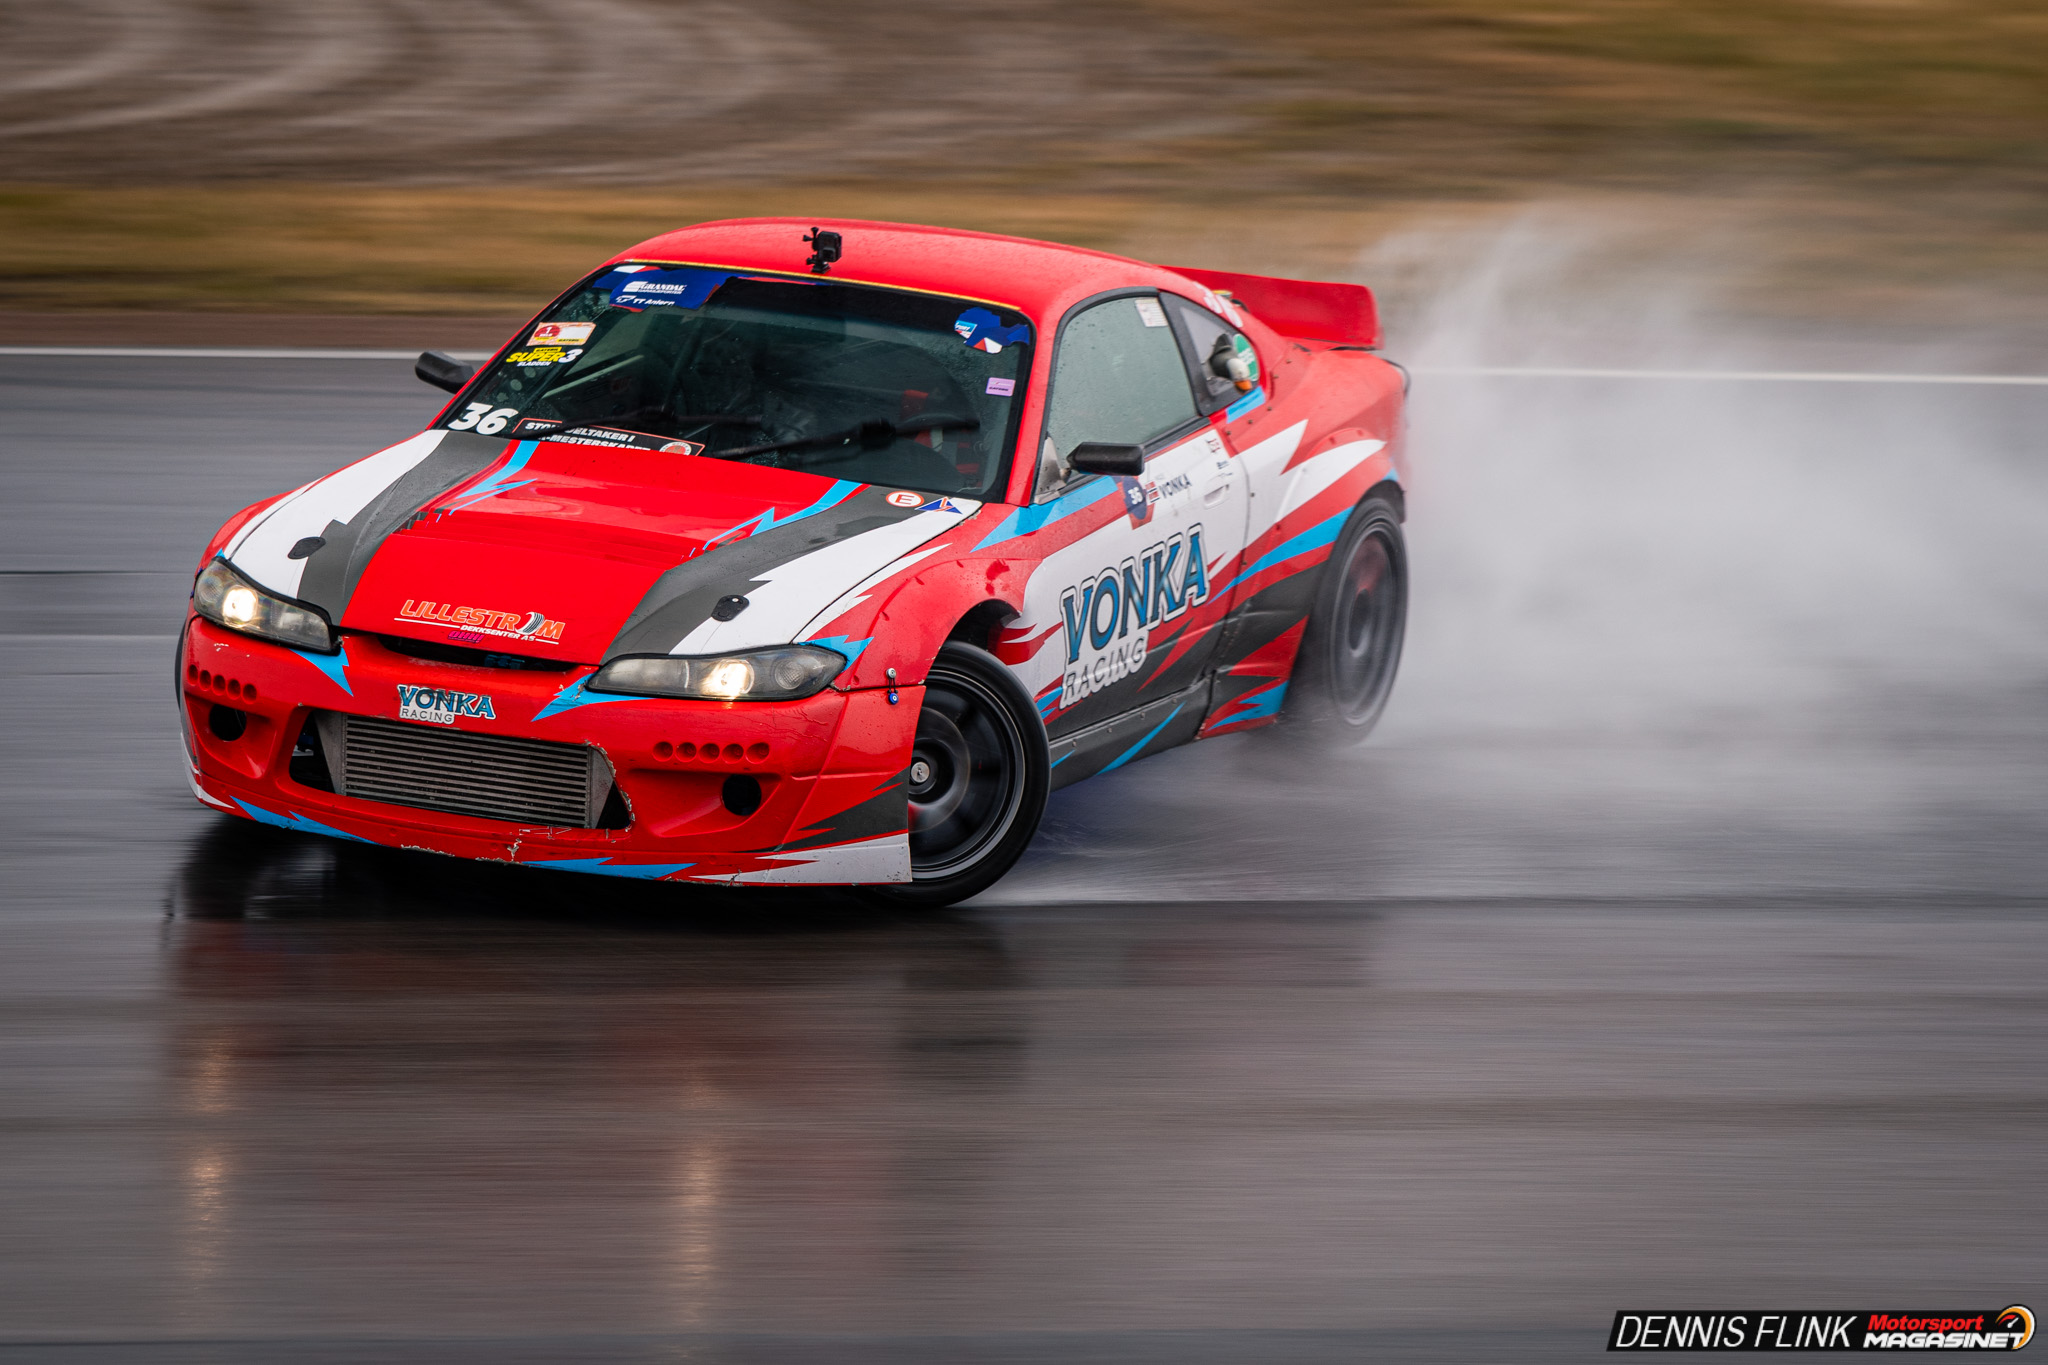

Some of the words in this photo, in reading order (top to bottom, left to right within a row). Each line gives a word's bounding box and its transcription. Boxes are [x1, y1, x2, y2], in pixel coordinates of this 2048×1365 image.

[447, 402, 519, 435] 36
[1157, 473, 1192, 499] VONKA
[1060, 525, 1210, 665] VONKA
[460, 625, 520, 640] DEKKSENTER
[520, 634, 536, 642] AS
[1062, 636, 1147, 702] RACING
[398, 684, 496, 719] VONKA
[401, 708, 454, 723] RACING
